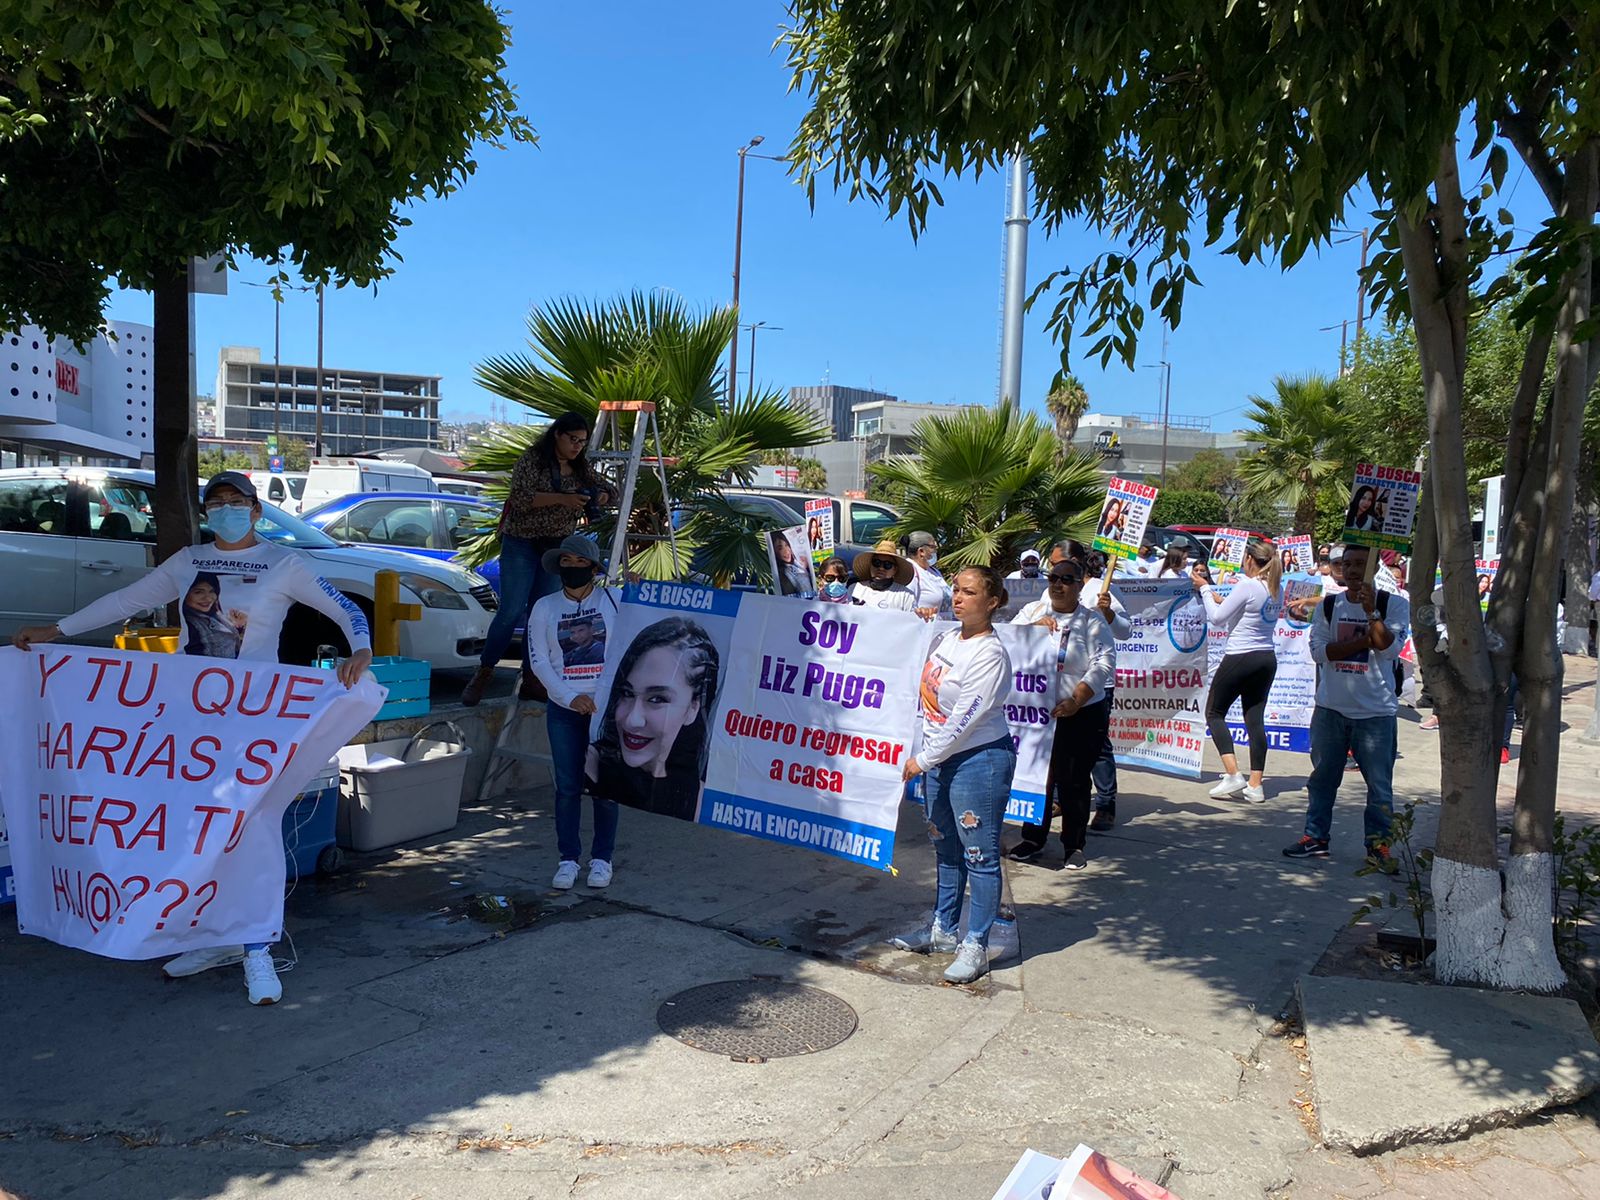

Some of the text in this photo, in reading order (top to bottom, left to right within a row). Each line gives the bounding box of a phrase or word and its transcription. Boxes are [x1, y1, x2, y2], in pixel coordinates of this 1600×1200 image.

[1357, 463, 1421, 484] SE BUSCA
[1109, 477, 1156, 500] SE BUSCA
[805, 497, 832, 511] SE BUSCA
[1227, 529, 1249, 538] BUSCA
[1287, 535, 1310, 545] BUSCA
[192, 558, 269, 570] DESAPARECIDA
[1475, 560, 1487, 568] SE
[639, 582, 714, 610] SE BUSCA
[799, 610, 858, 655] Soy
[1278, 628, 1303, 640] Puga
[1116, 643, 1158, 653] URGENTES
[38, 653, 324, 720] Y TU, QUE
[759, 656, 886, 710] Liz Puga
[1015, 671, 1047, 694] tus
[1152, 669, 1203, 689] PUGA
[1110, 698, 1200, 713] NCONTRARLA
[1127, 718, 1138, 728] QUE
[1140, 718, 1164, 730] VUELVA
[1174, 720, 1191, 733] CASA
[724, 708, 903, 767] Quiero regresar
[37, 721, 299, 786] HARÍAS SI
[770, 760, 844, 794] a casa
[39, 793, 167, 852] FUERA
[711, 801, 880, 861] HASTA ENCONTRARTE
